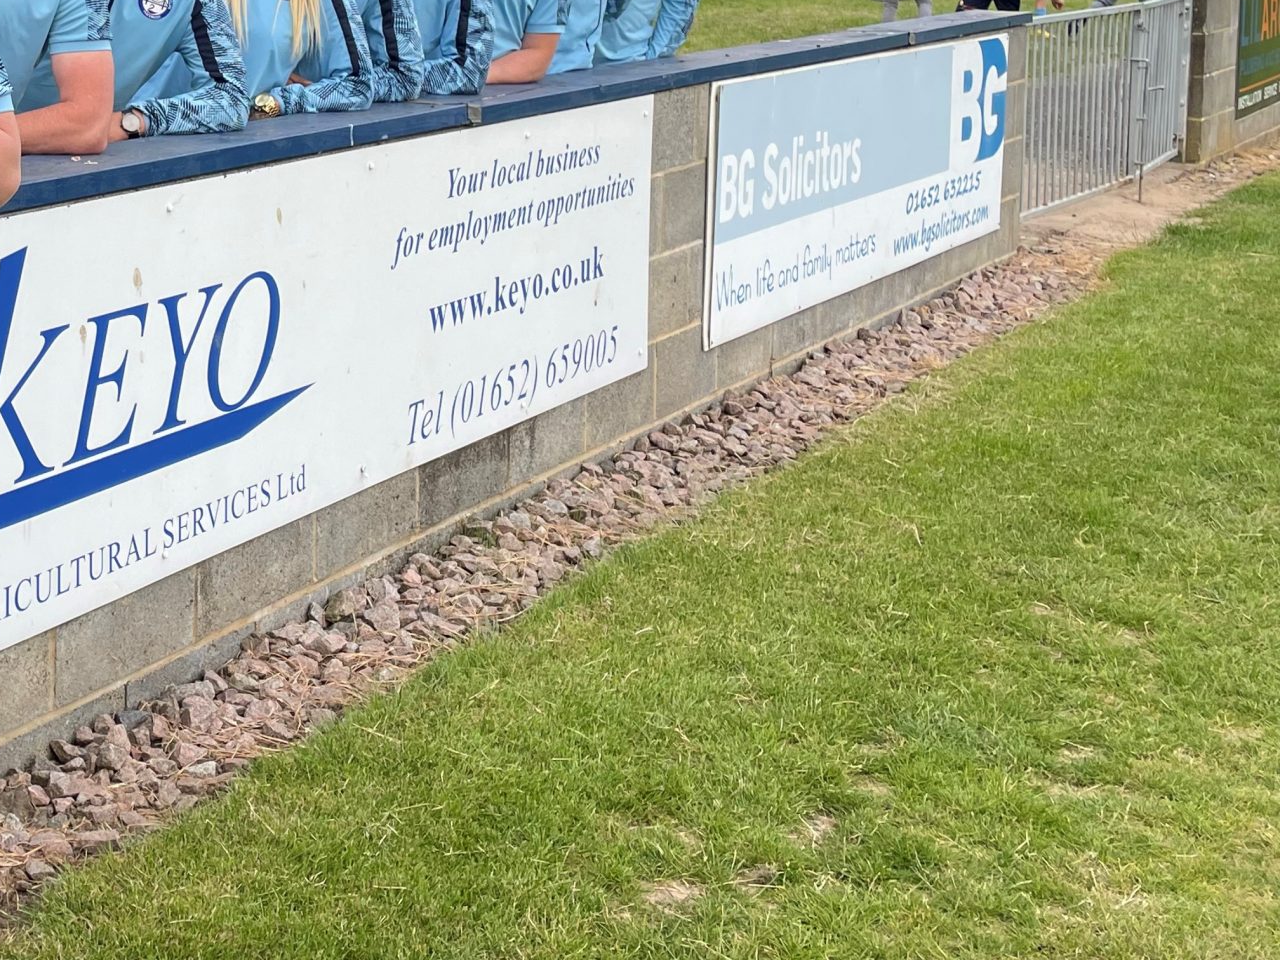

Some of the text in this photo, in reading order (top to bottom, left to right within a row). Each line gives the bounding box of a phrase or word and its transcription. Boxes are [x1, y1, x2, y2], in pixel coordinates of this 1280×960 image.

[447, 144, 601, 198] Your local business
[719, 130, 862, 224] BG Solicitors
[906, 170, 982, 215] 01652 632215
[391, 173, 635, 270] for employment opportunities
[893, 204, 989, 257] www.bgsolicitors.com
[429, 246, 604, 333] www.keyo.co.uk
[716, 232, 876, 311] When life and family matters
[406, 325, 618, 446] Tel (01652) 659005
[162, 478, 271, 550] SERVICES
[275, 463, 307, 502] Ltd
